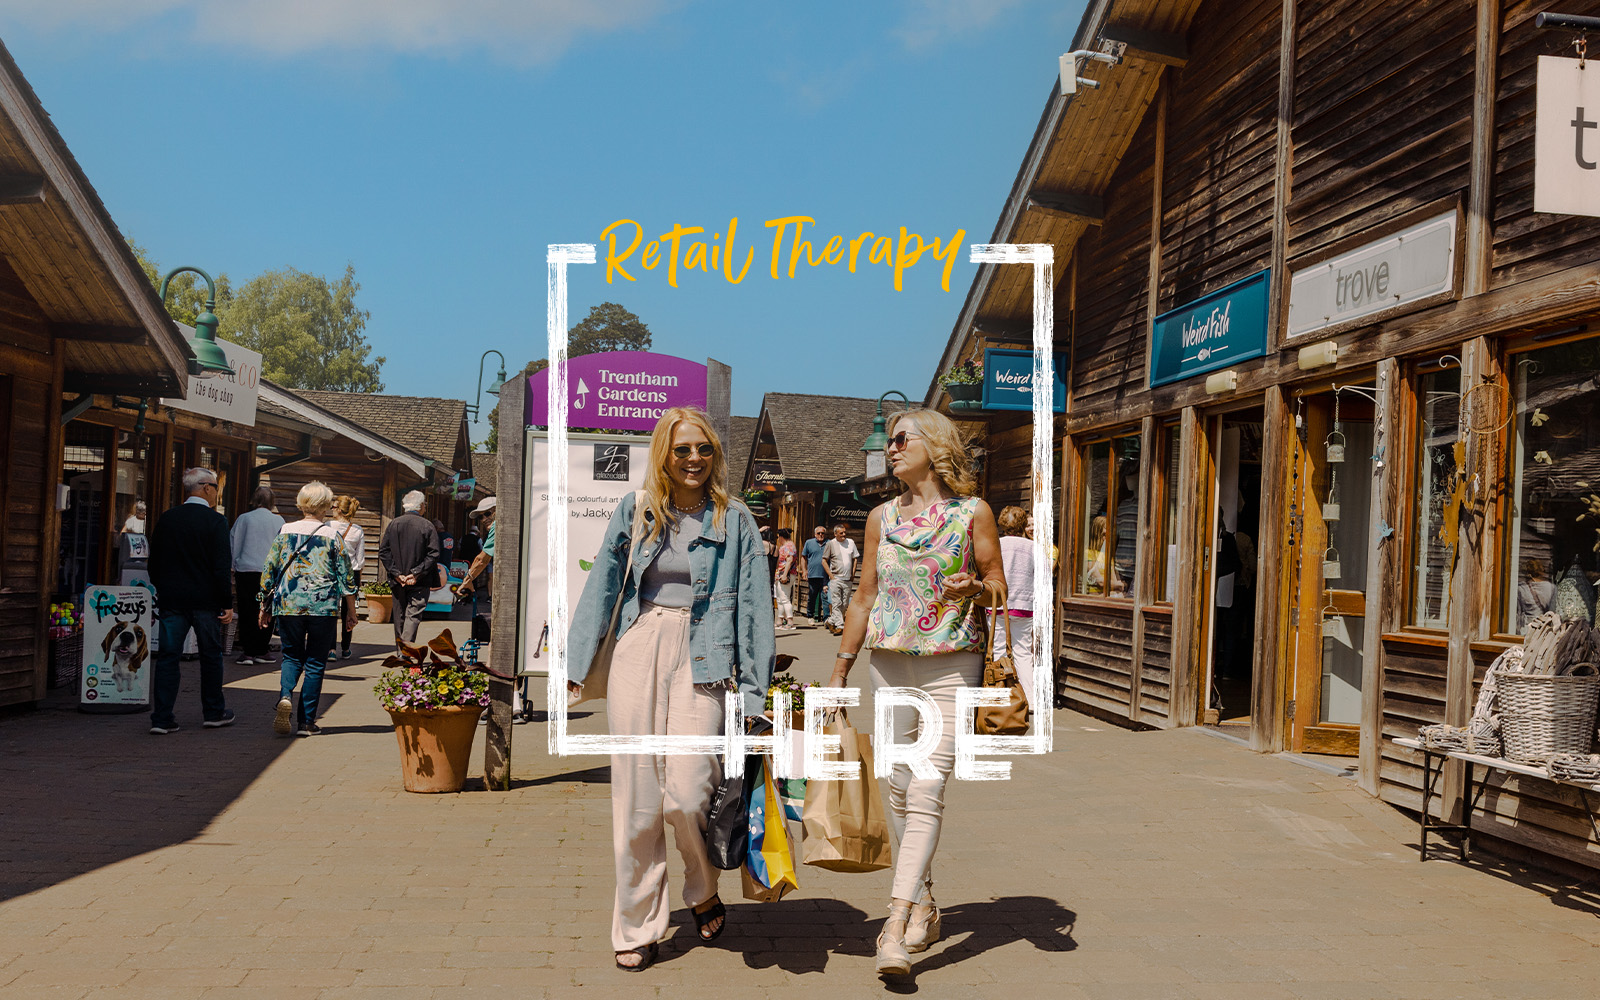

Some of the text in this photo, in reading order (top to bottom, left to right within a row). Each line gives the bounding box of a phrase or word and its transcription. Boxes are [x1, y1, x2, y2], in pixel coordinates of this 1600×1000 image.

[1335, 260, 1390, 307] trove
[1182, 300, 1231, 348] Weird Fish
[598, 369, 678, 387] Trentham
[995, 368, 1031, 384] Weird
[195, 381, 234, 406] the dog shop
[598, 386, 668, 403] Gardens
[571, 507, 614, 520] by Jacky
[830, 505, 868, 518] Thornton
[95, 592, 147, 624] frozzys
